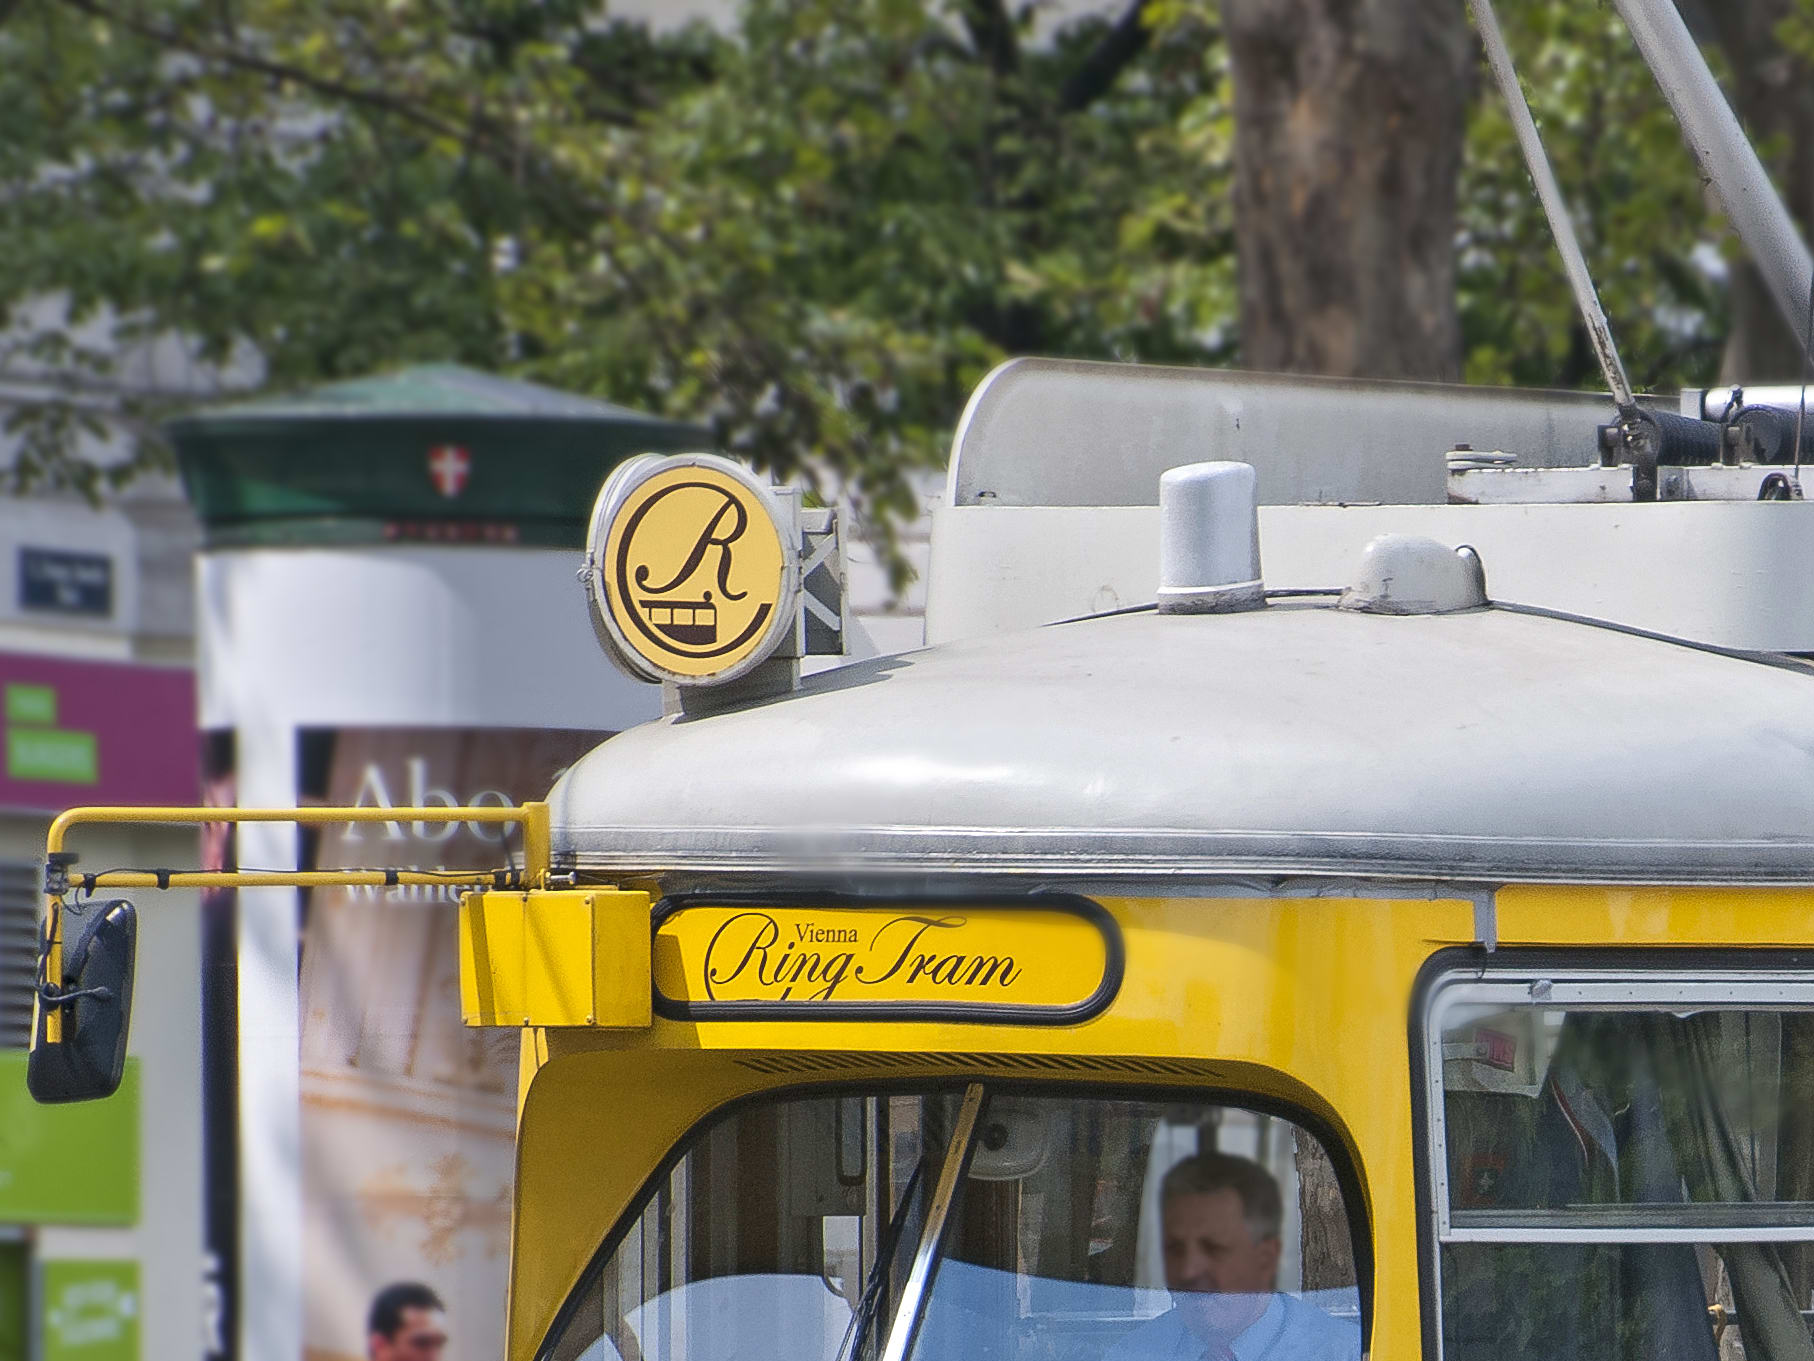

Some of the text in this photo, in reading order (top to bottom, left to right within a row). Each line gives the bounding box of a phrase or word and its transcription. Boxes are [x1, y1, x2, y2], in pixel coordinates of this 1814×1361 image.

[340, 758, 516, 842] Abo
[703, 912, 1022, 1000] Ring Tram
[795, 923, 858, 943] Vienna
